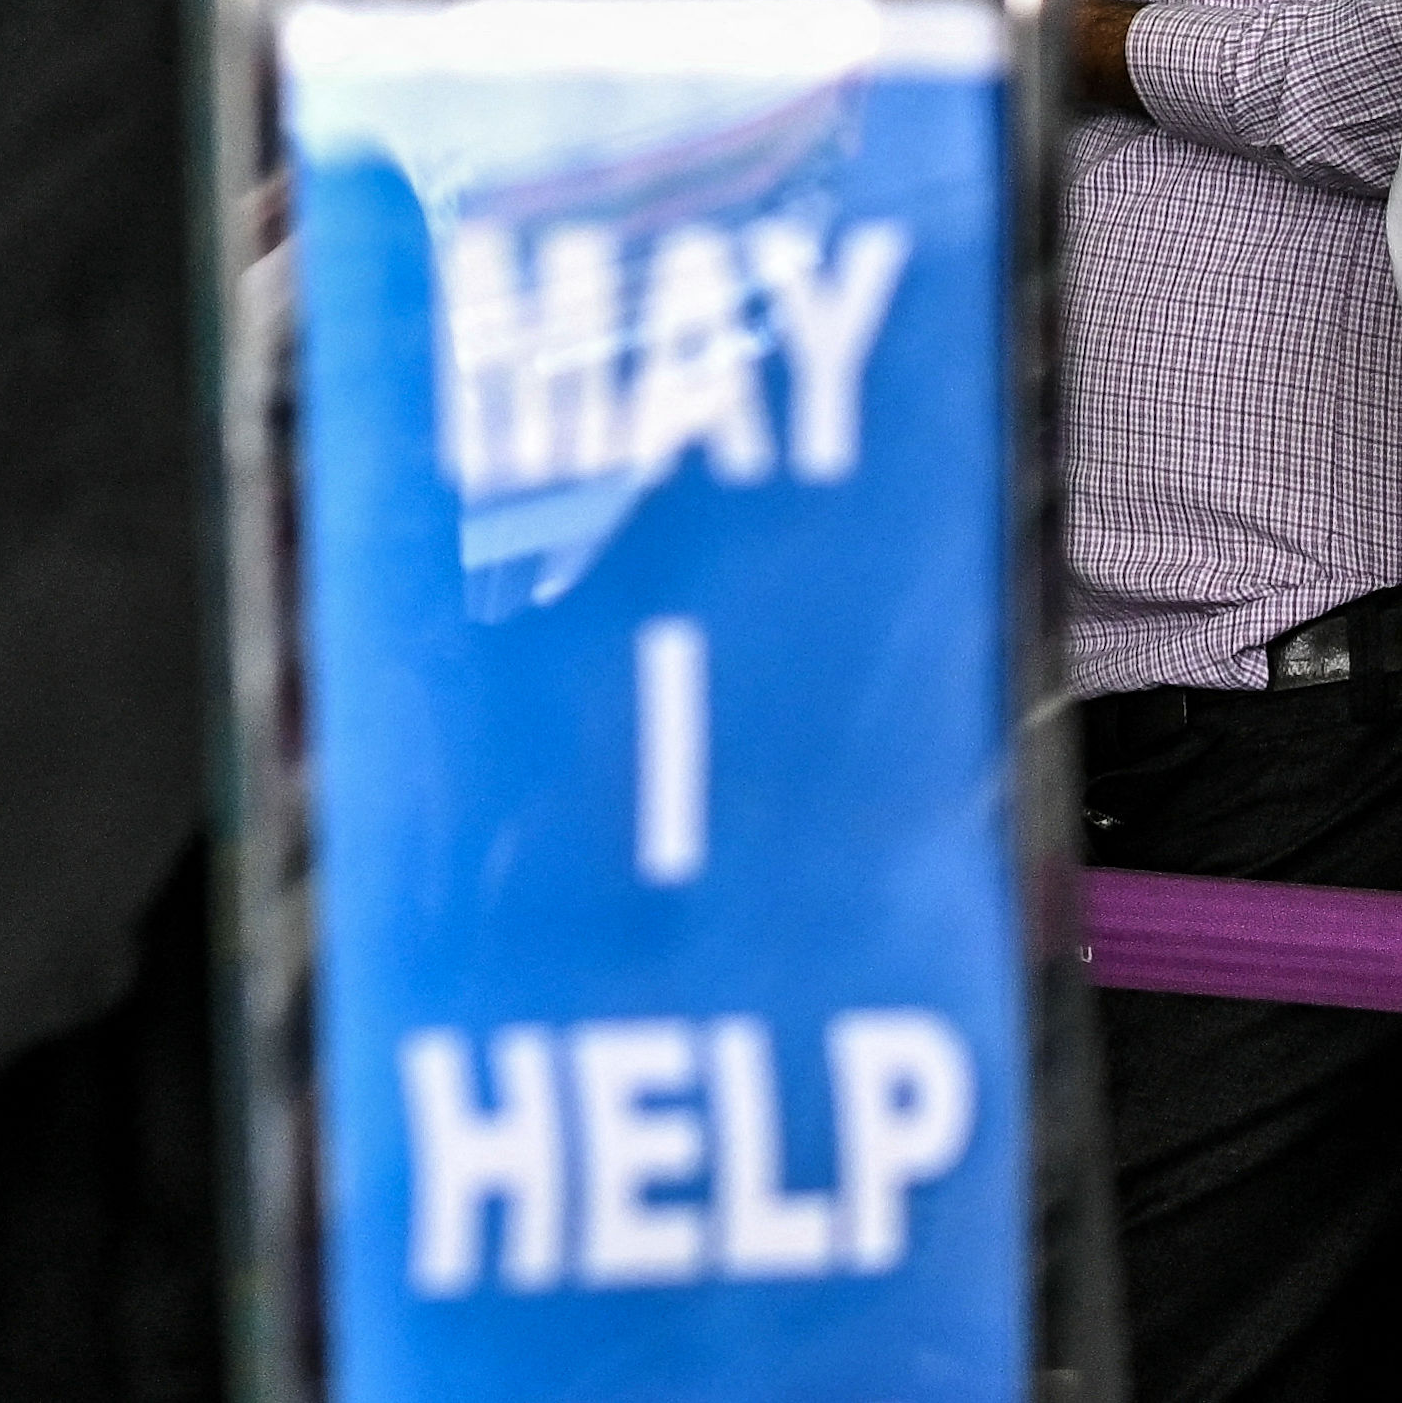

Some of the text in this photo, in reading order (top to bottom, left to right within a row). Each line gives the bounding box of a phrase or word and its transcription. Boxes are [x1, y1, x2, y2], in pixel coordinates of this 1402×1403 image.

[438, 216, 909, 488] MAY
[631, 616, 713, 888] I
[401, 1007, 978, 1295] HELP
